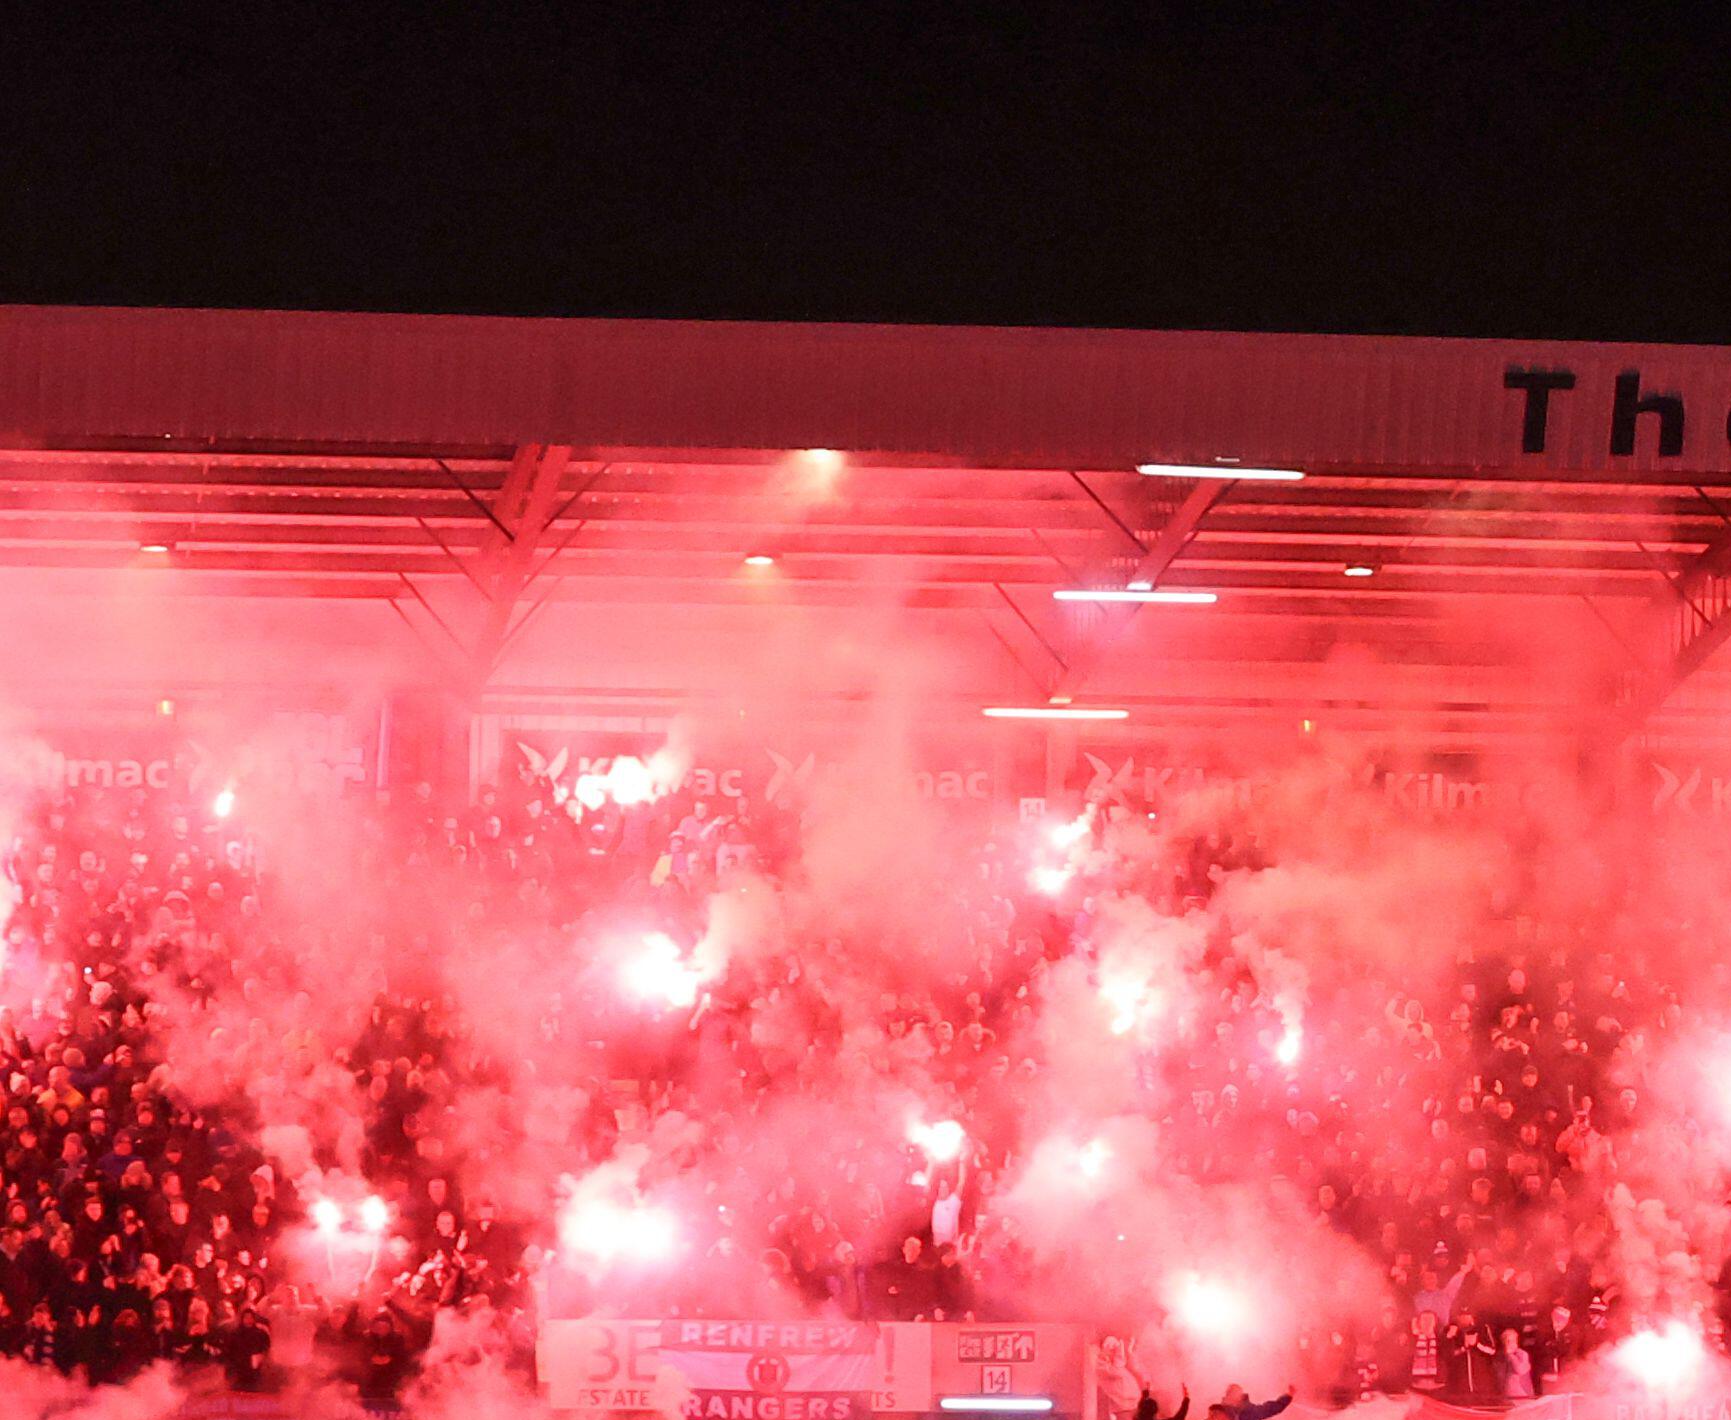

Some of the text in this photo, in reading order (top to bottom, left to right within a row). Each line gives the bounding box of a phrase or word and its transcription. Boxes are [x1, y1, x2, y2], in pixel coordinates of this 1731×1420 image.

[681, 1323, 858, 1349] RENFREW
[988, 1371, 1008, 1390] 14
[682, 1395, 852, 1420] RANGERS
